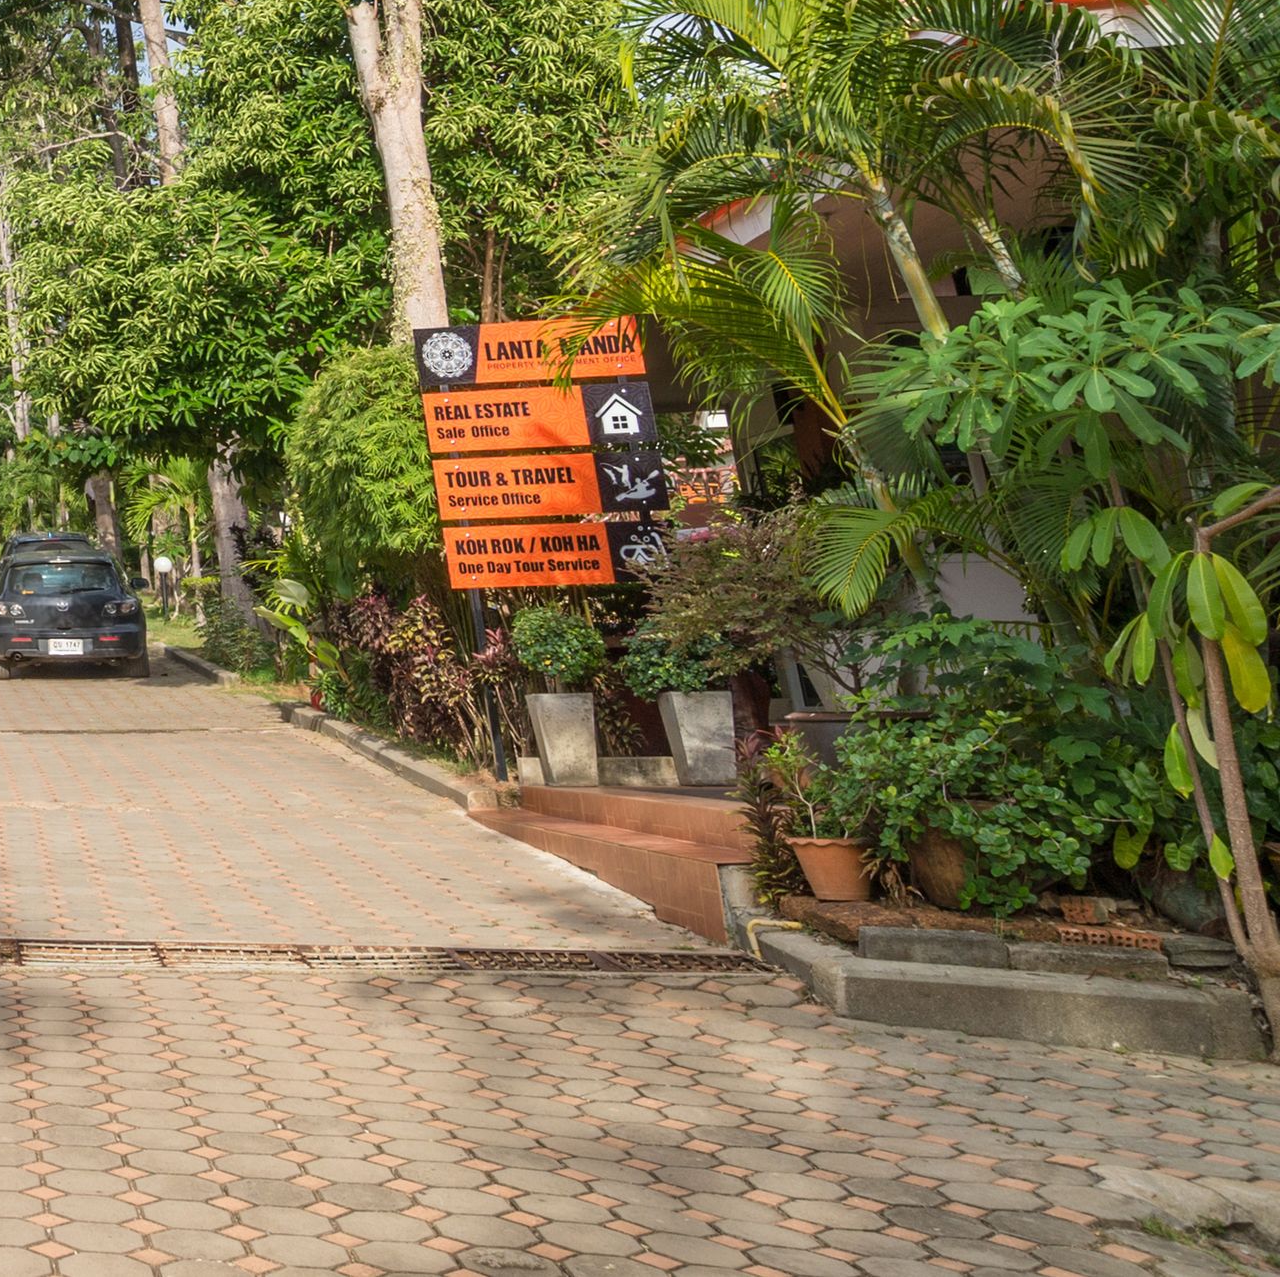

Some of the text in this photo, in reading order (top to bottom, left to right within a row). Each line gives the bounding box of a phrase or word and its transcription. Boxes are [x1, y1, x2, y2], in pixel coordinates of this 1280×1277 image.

[487, 354, 637, 371] PROPERTY MAAMENT OFFICE
[434, 402, 531, 421] REAL ESTATE
[437, 425, 510, 440] Sale Office
[445, 467, 576, 488] TOUR & TRAVEL
[448, 492, 541, 507] Service Office
[455, 534, 601, 555] KOH ROK / KOH HA
[458, 558, 600, 575] One Day Tour Service
